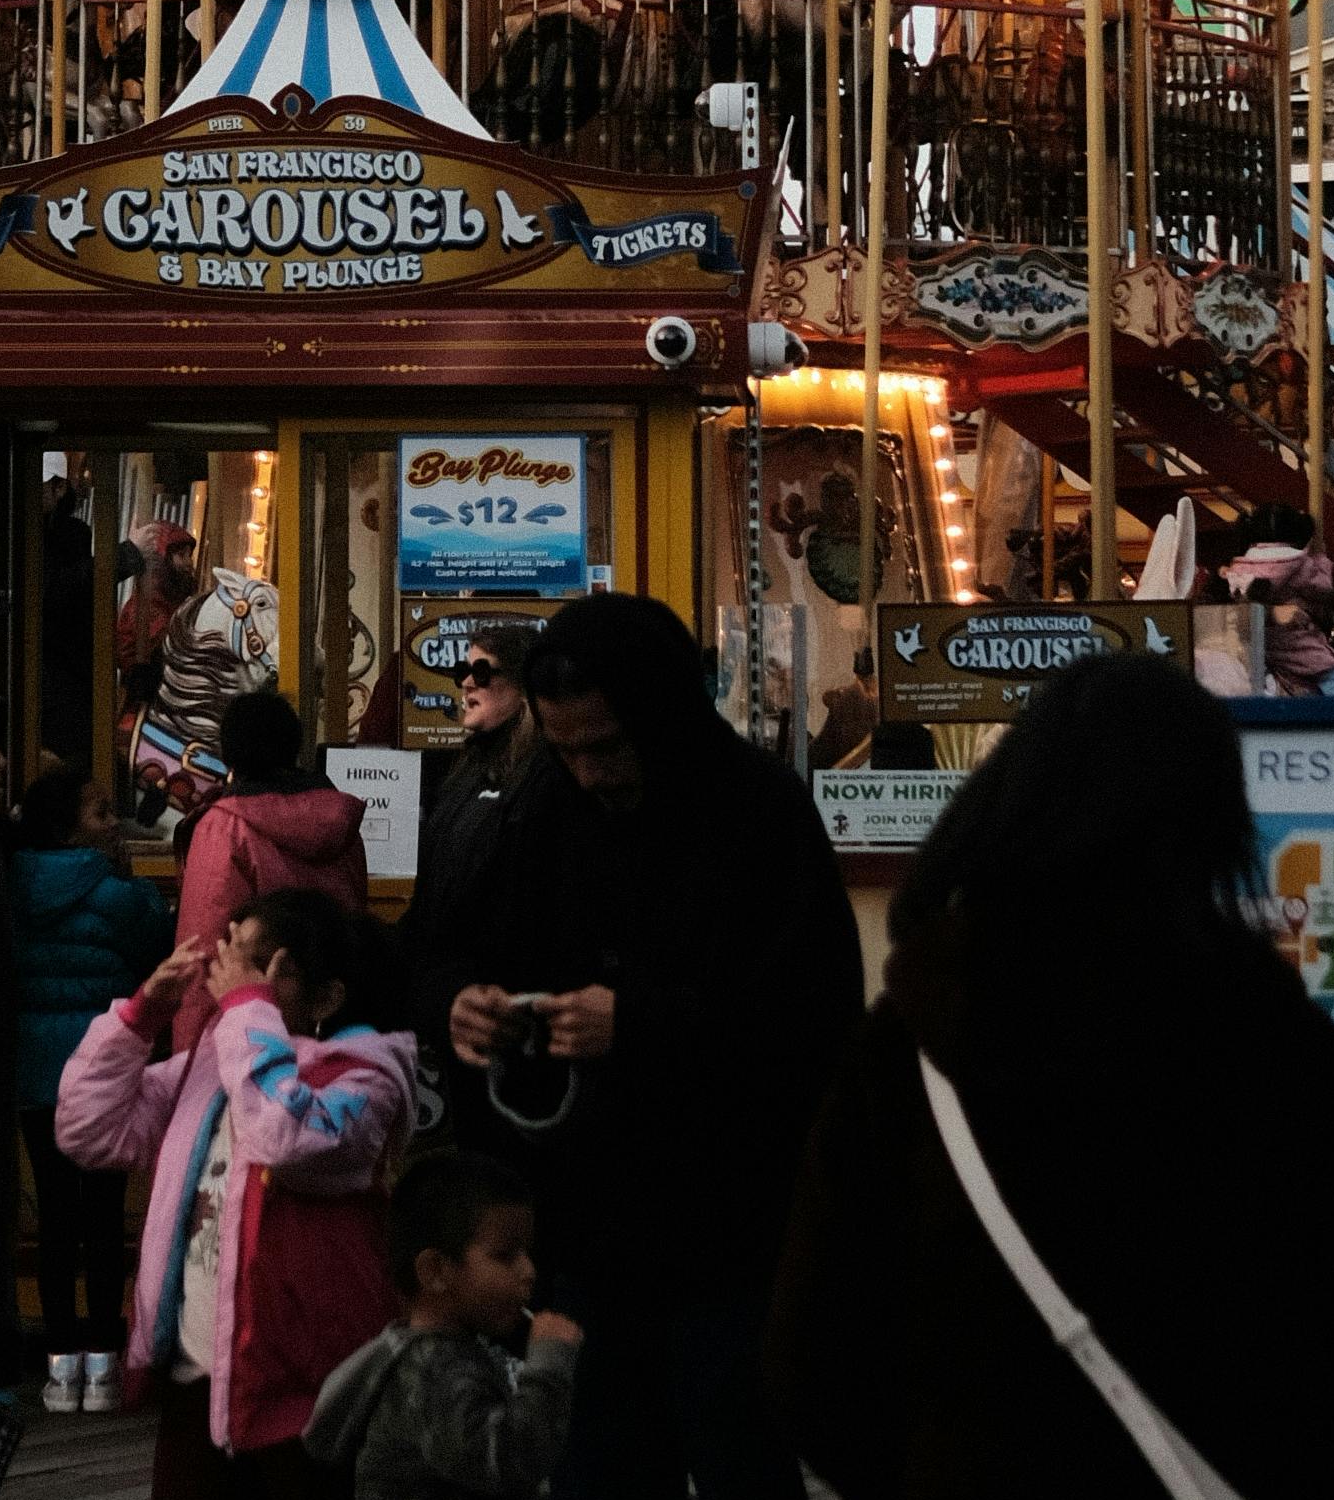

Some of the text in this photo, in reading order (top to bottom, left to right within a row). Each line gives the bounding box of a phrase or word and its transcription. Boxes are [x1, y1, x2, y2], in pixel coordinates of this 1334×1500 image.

[208, 115, 366, 131] PIER 39
[163, 150, 423, 184] SAN FRANCISCO
[103, 187, 486, 250] CAROUSEL
[591, 221, 708, 261] TICKETS
[159, 253, 422, 289] & BAY PLUNGE
[407, 448, 573, 486] Bay Plunge
[457, 496, 518, 527] $12
[438, 618, 467, 635] SAN
[967, 615, 1092, 634] SAN FRANCISCO
[346, 768, 399, 780] HIRING
[822, 784, 884, 800] NOW
[365, 798, 390, 810] OW
[863, 815, 933, 824] JOIN OUR
